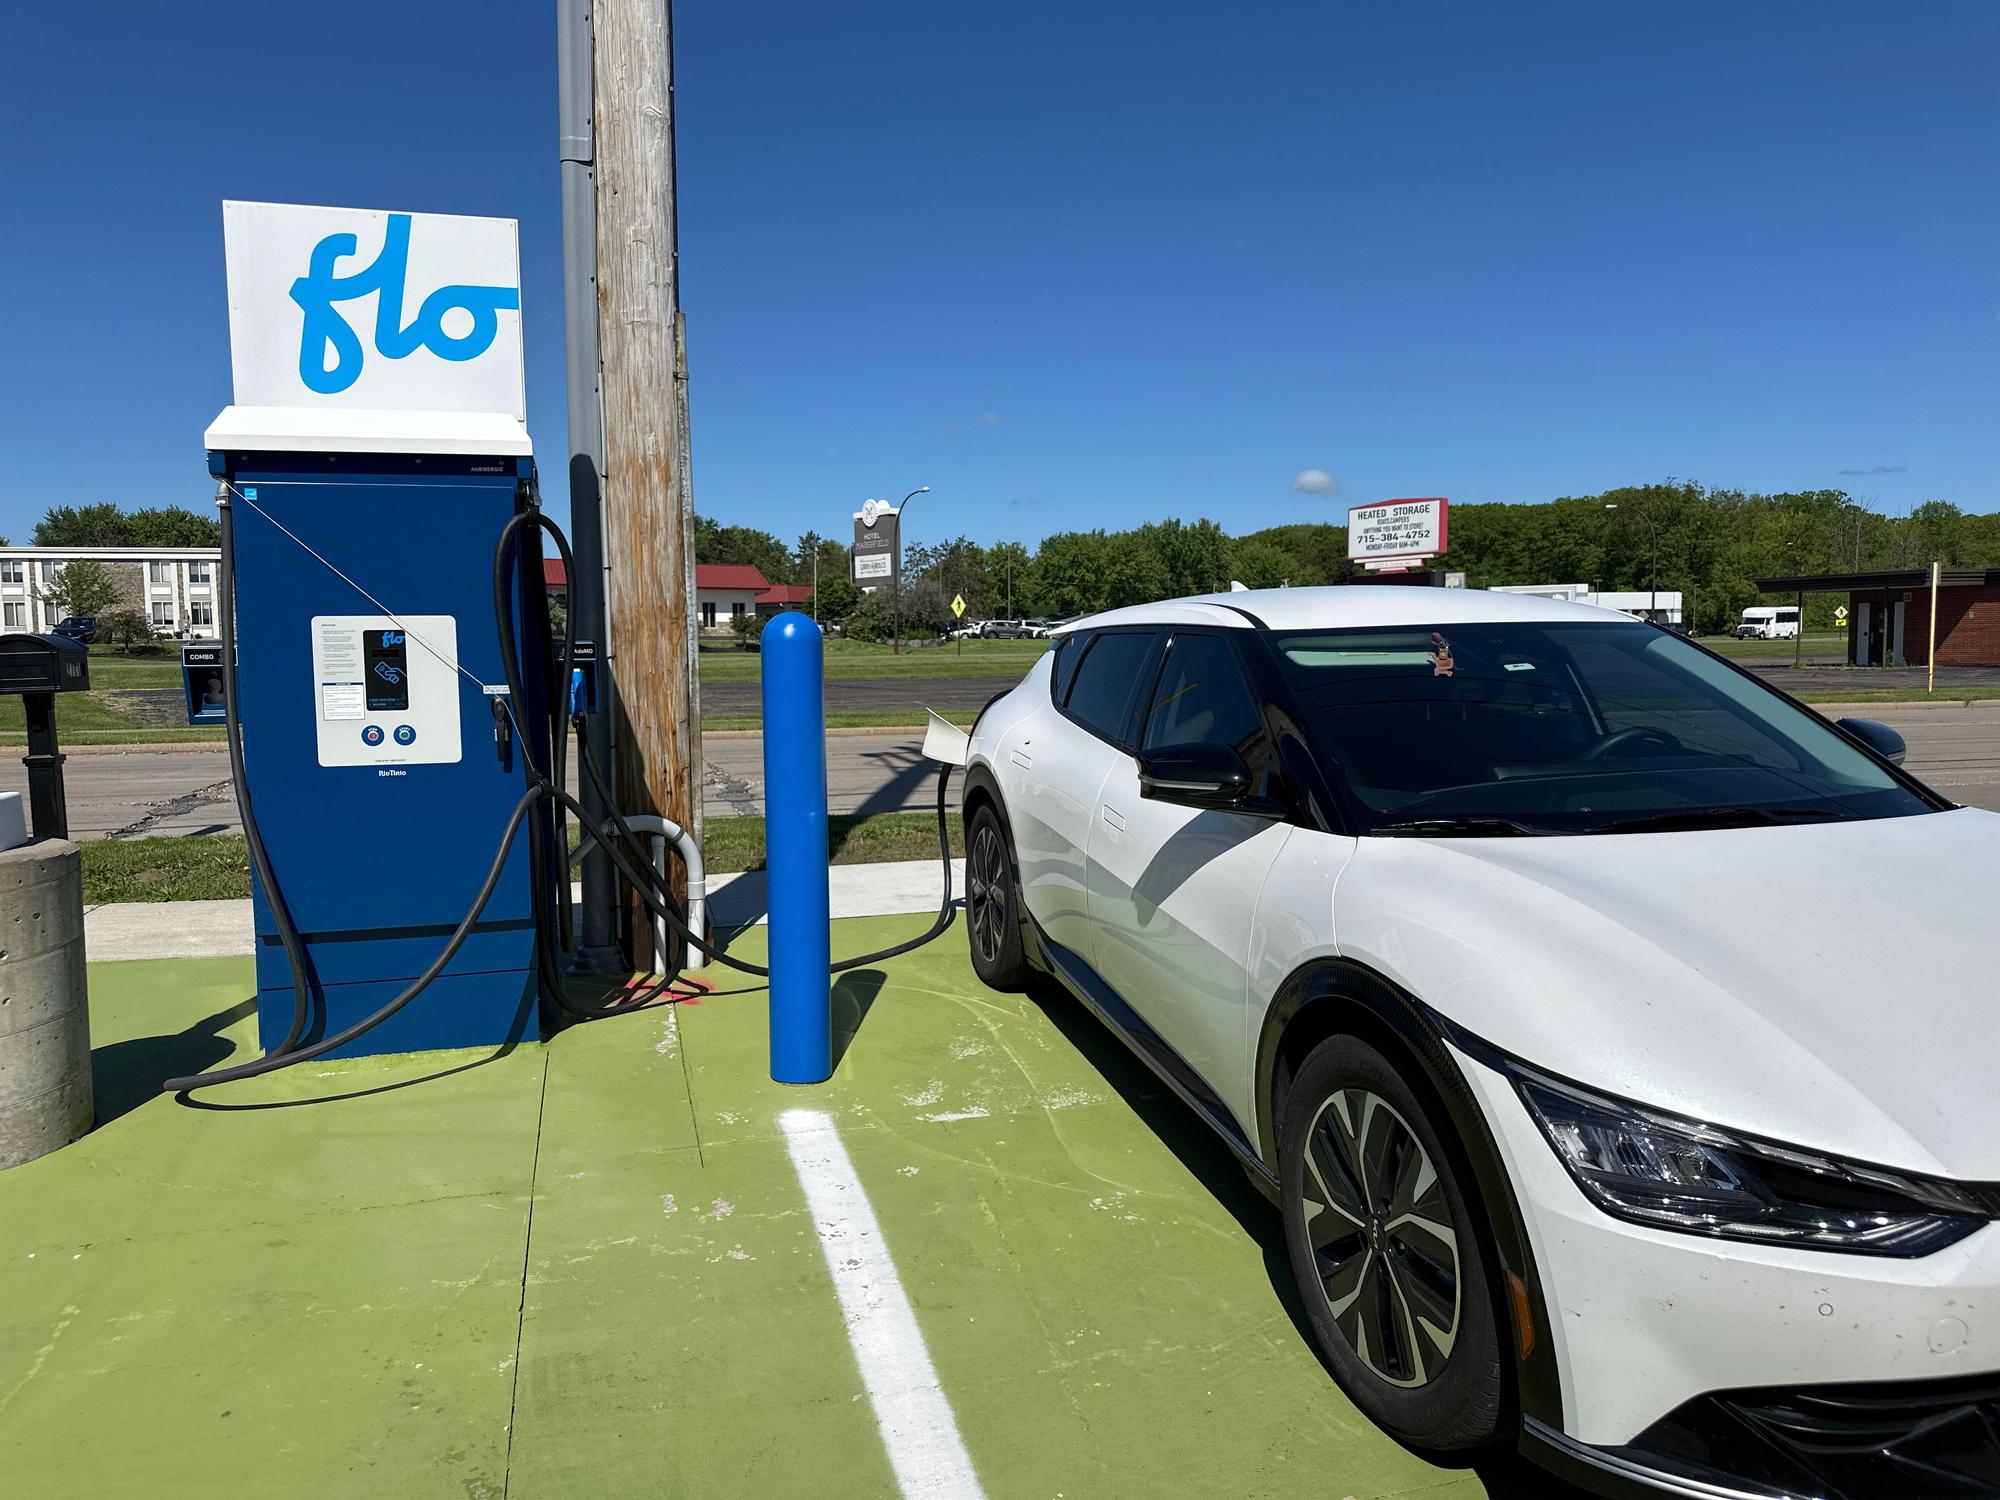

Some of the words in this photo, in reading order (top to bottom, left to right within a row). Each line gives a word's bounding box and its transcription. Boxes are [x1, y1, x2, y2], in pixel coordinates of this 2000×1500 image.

[288, 213, 519, 394] flo
[1357, 509, 1387, 520] HEATED
[1393, 504, 1430, 516] STORAGE
[864, 532, 880, 540] HOTEL
[1363, 526, 1382, 534] ANYTHING
[1392, 524, 1403, 532] WANT
[1357, 530, 1430, 543] 715-384-4752
[382, 632, 407, 648] flo
